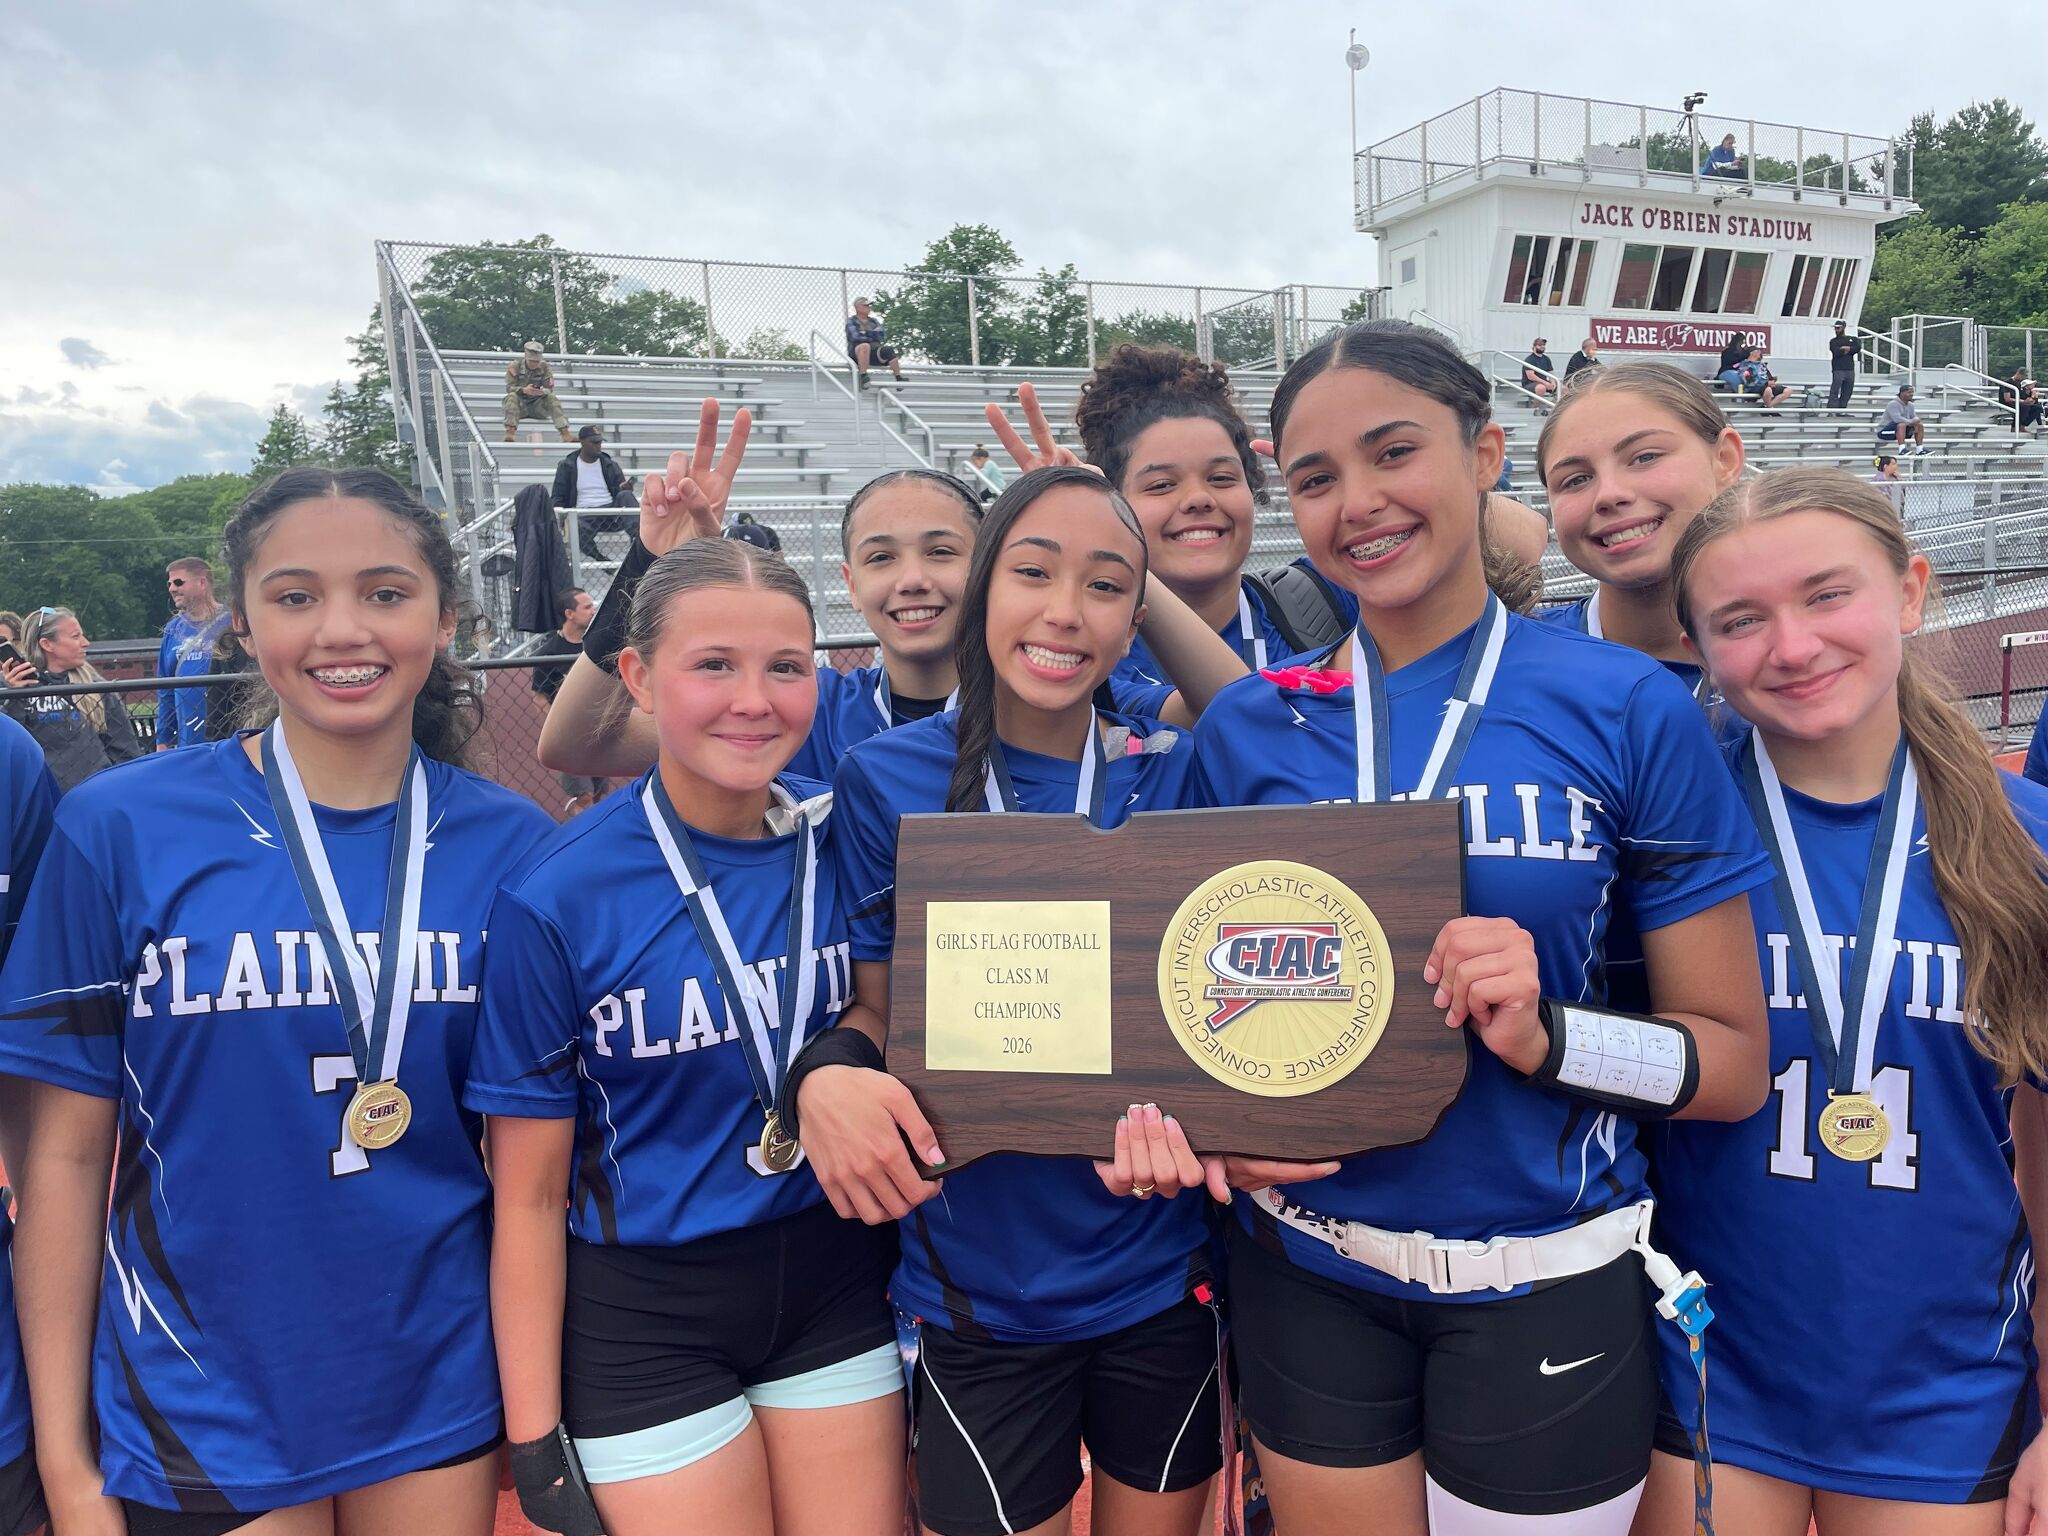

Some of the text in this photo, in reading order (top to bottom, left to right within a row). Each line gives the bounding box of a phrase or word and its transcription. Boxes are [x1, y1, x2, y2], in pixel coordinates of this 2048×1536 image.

[1581, 203, 1812, 242] JACK O'BRIEN STADIUM
[1595, 325, 1622, 344] WE
[1625, 326, 1658, 345] ARE
[1693, 328, 1767, 349] WINDOR
[936, 933, 1101, 950] GIRLS FLAG FOOTBALL
[1228, 936, 1344, 978] CIAC
[986, 967, 1049, 984] CLASS M
[1174, 876, 1377, 1080] CONNECTICUT INTERSCHOLASTIC ATHLETIC CONFERENCE
[1209, 987, 1351, 998] CONNECTICUT INTERSCHOLASTIC ATHLETIC CONFERENCE
[974, 1001, 1061, 1020] CHAMPIONS
[1002, 1036, 1033, 1054] 2026
[311, 1054, 372, 1178] 7
[368, 1101, 401, 1120] CIAC
[1768, 1056, 1919, 1191] 14
[1840, 1117, 1875, 1129] CIAC
